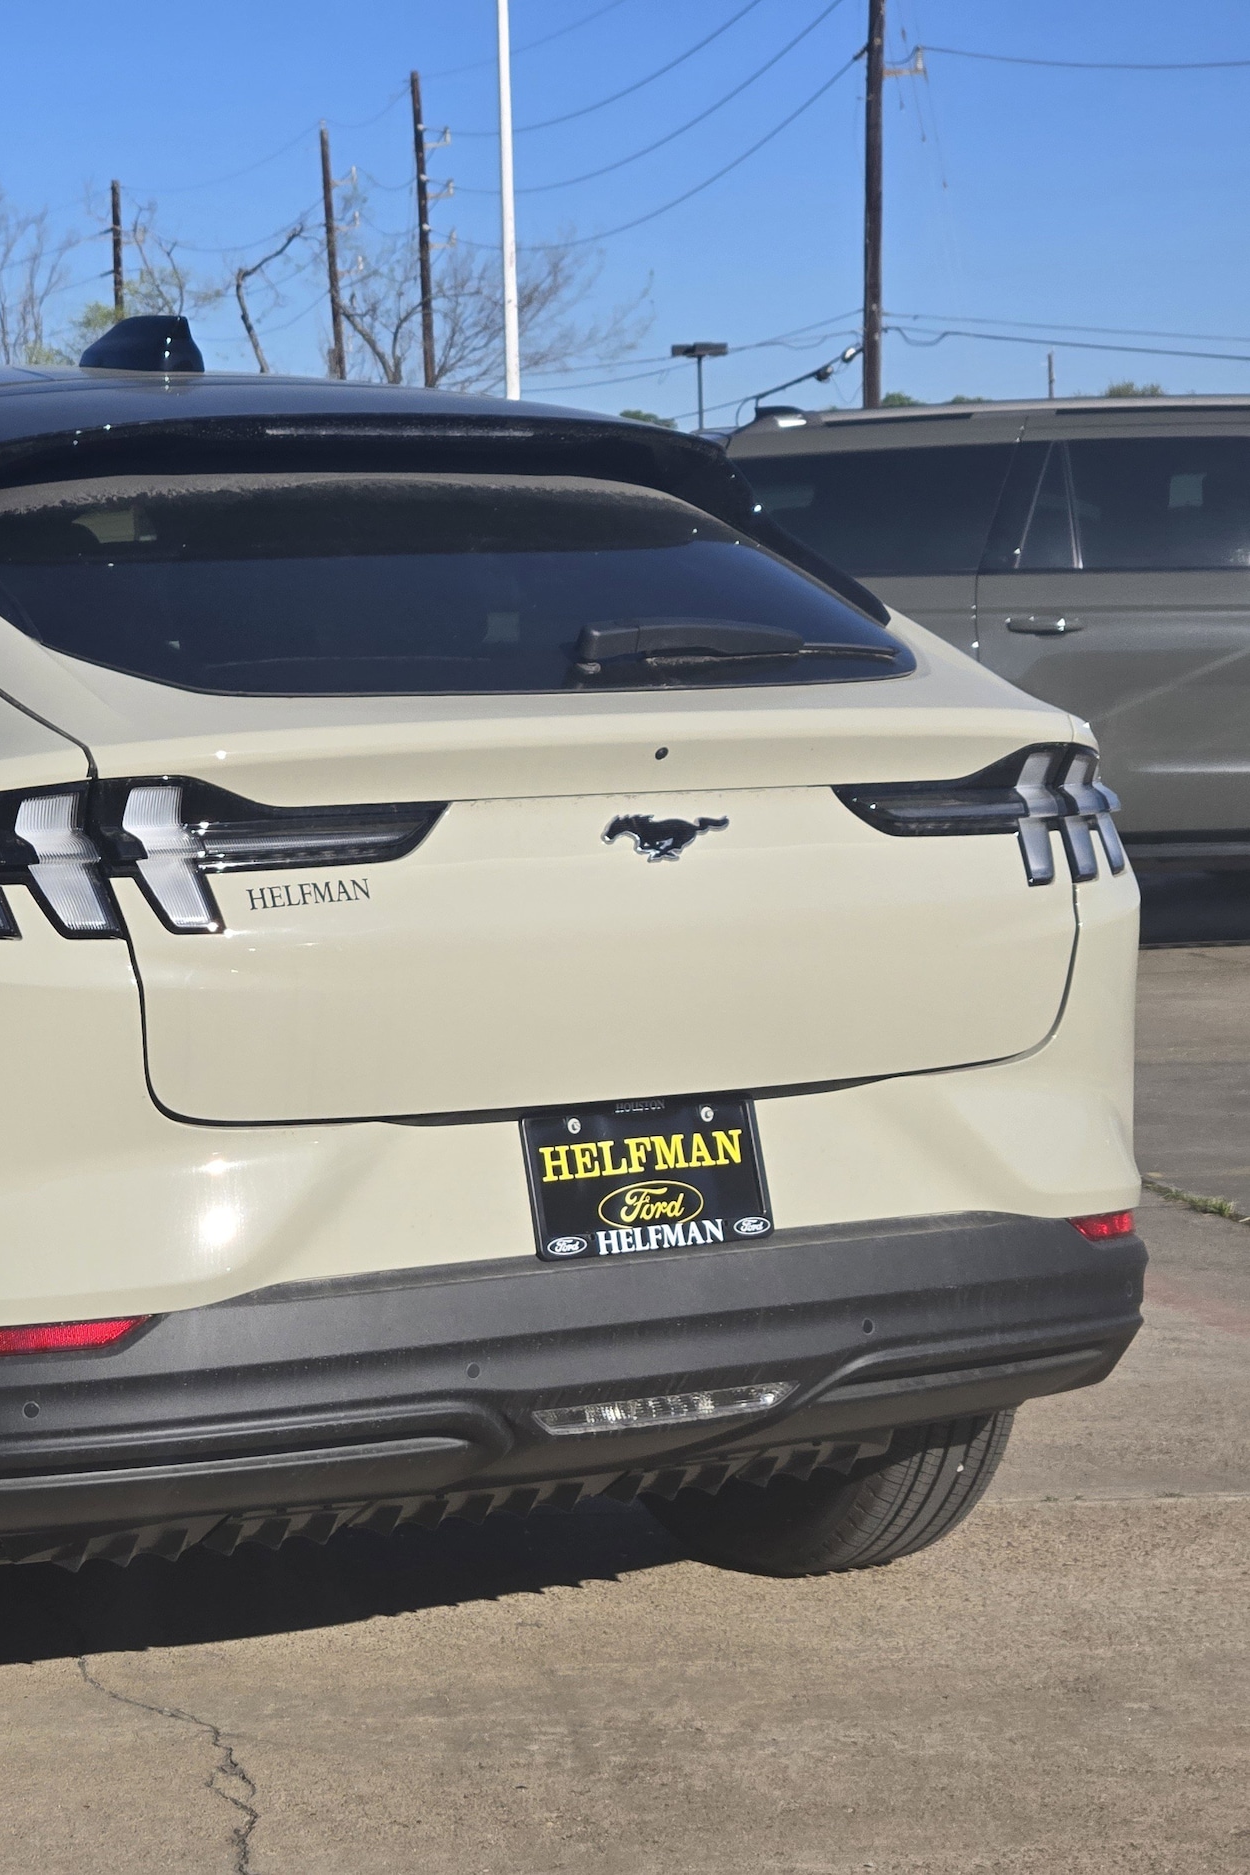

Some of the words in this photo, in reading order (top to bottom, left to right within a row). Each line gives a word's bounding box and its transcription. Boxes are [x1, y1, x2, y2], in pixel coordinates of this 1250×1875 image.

[246, 878, 371, 910] HELFMAN
[538, 1129, 742, 1182] HELFMAN
[620, 1186, 684, 1223] Ford
[595, 1218, 725, 1256] HELFMAN
[740, 1219, 763, 1232] Ford
[554, 1239, 580, 1253] Ford
